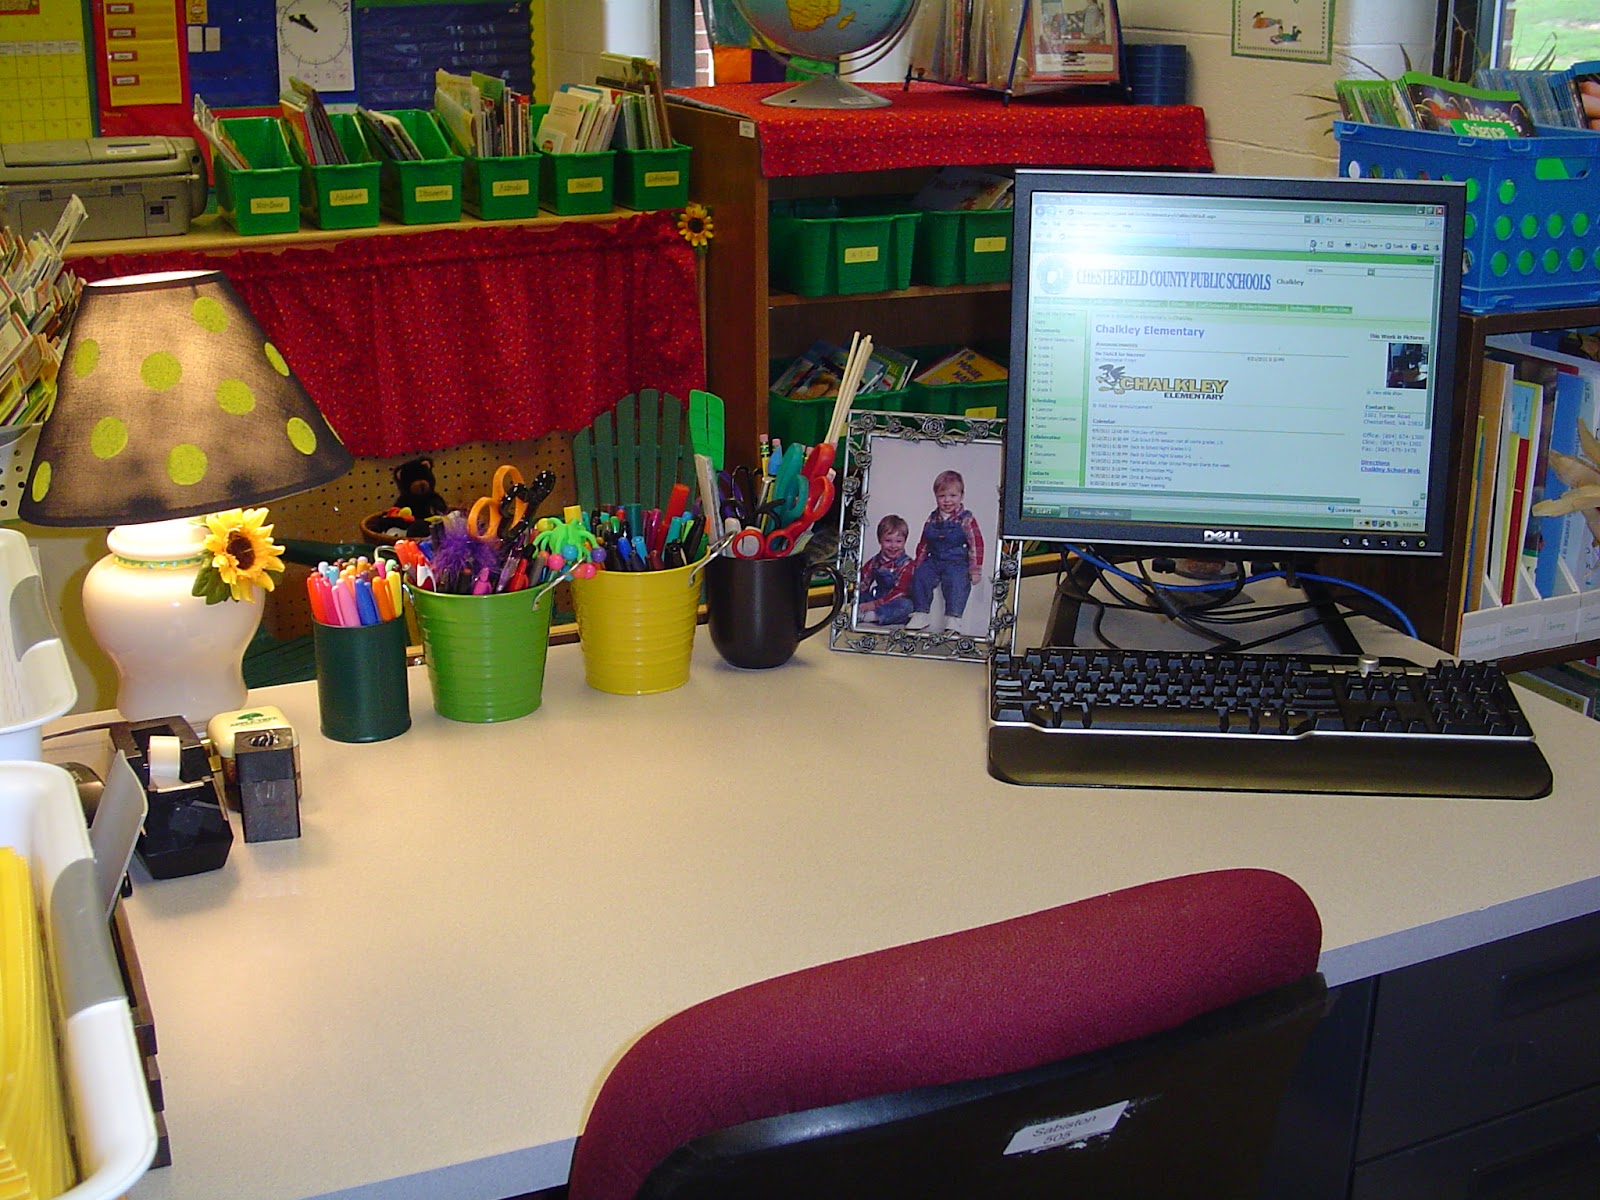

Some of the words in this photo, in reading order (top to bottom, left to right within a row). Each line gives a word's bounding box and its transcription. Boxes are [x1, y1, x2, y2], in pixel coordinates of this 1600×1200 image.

[1077, 269, 1148, 287] CHESTERFIELD
[1150, 271, 1190, 288] COUNTY
[1190, 272, 1226, 290] PUBLIC
[1226, 272, 1271, 290] SCHOOLS
[1277, 278, 1304, 287] Chalkley
[1096, 324, 1141, 336] Chalkley
[1144, 326, 1205, 338] Elementary
[1120, 376, 1229, 393] CHALKLEY
[1164, 392, 1224, 400] ELEMENTARY
[1203, 530, 1242, 543] DELL
[1043, 1130, 1072, 1144] 505
